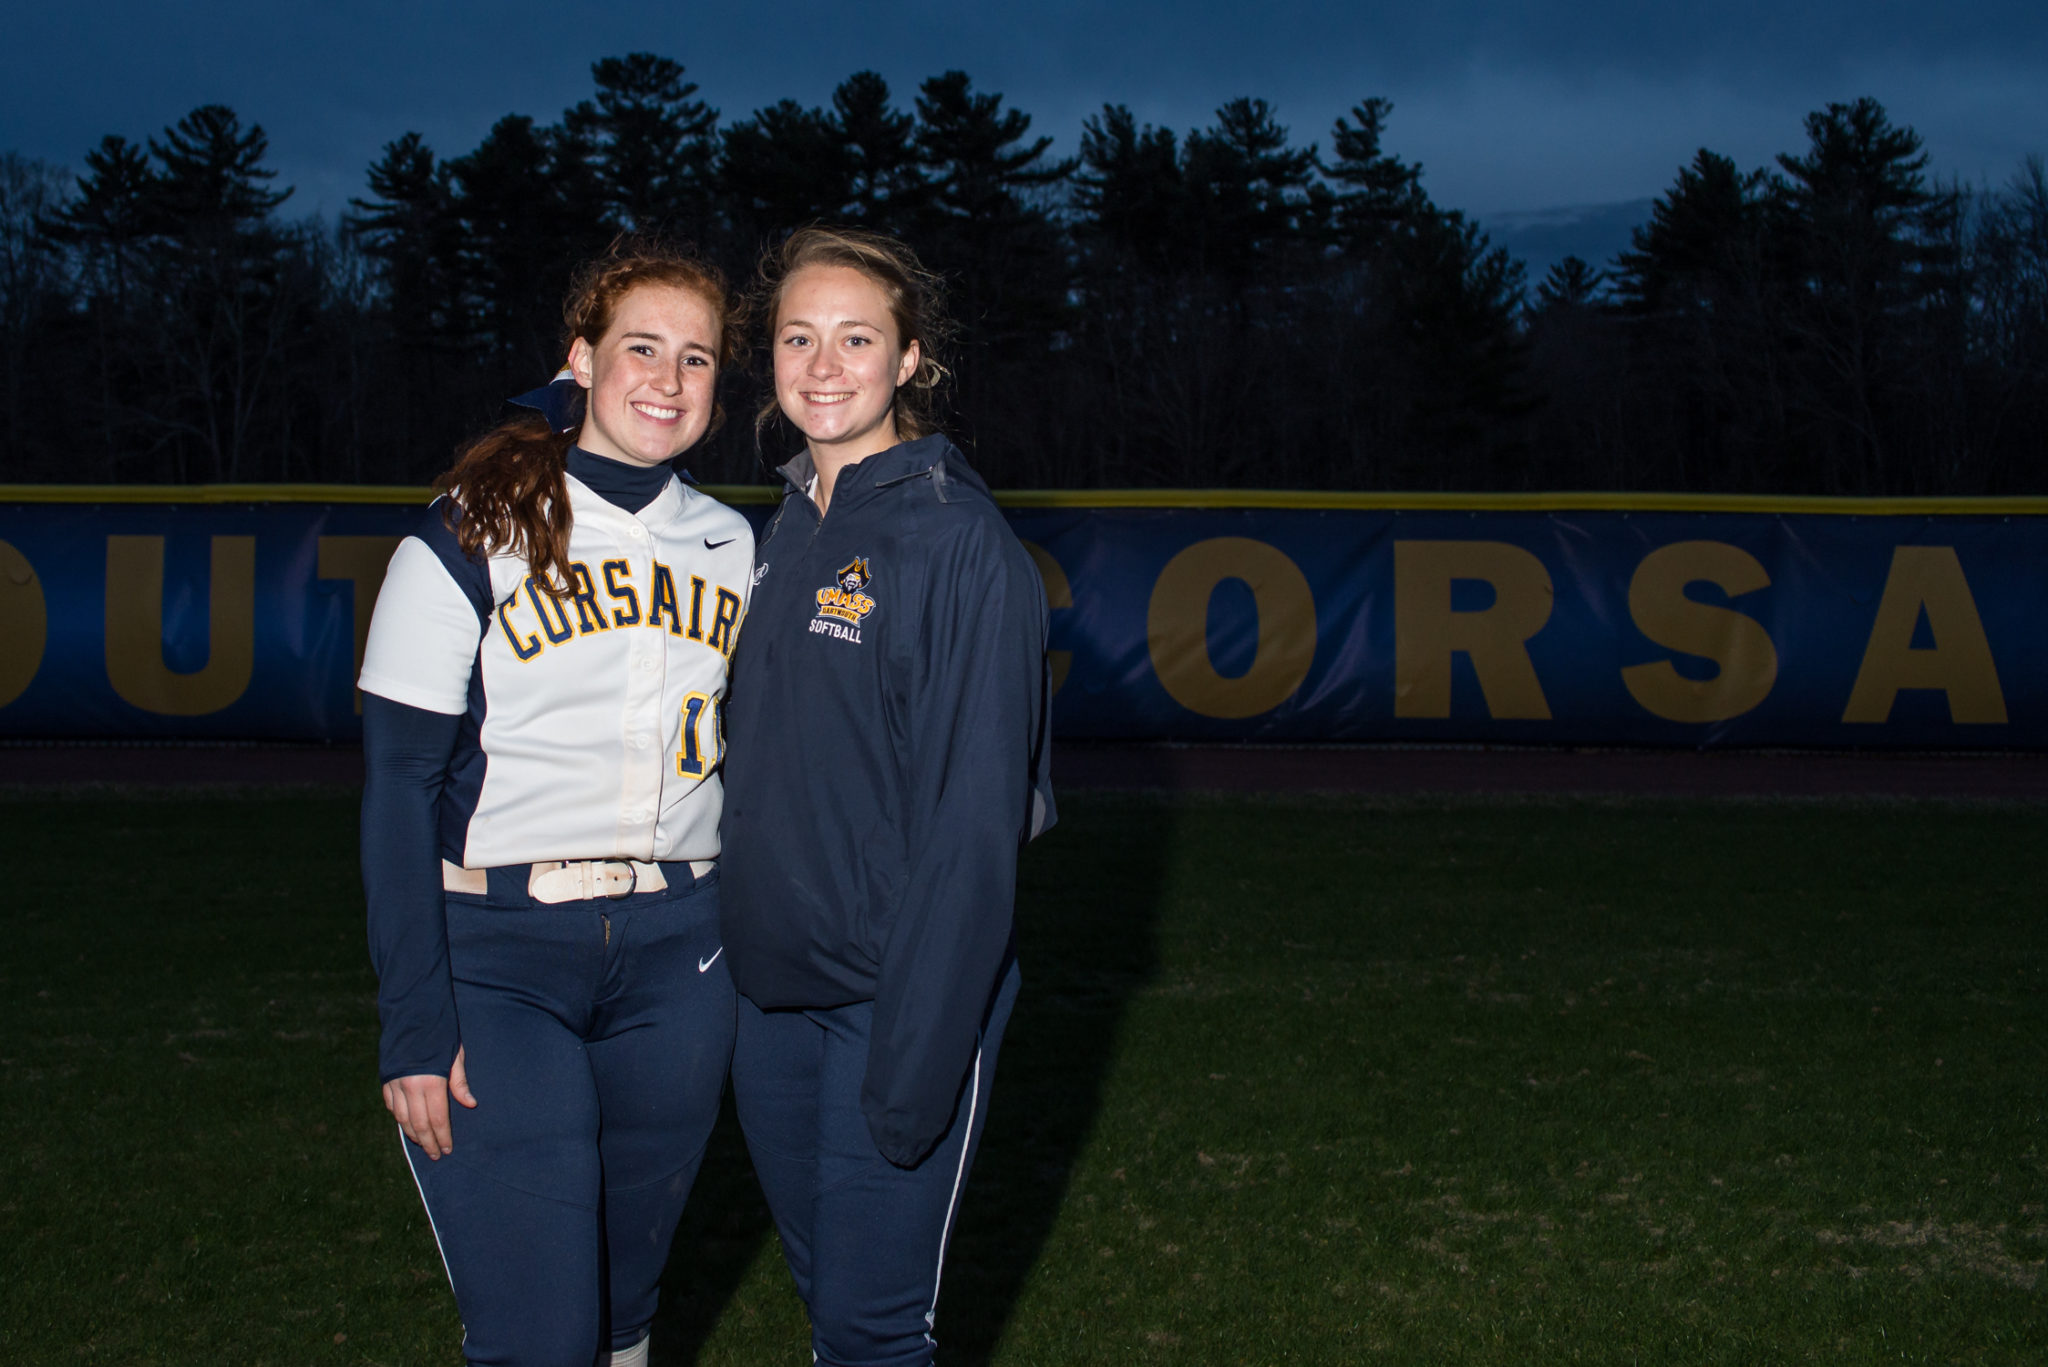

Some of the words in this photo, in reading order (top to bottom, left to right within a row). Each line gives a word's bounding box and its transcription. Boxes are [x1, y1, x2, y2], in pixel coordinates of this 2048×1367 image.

[816, 588, 875, 615] UMASS
[808, 618, 862, 645] SOFTBALL
[676, 690, 724, 781] 1
